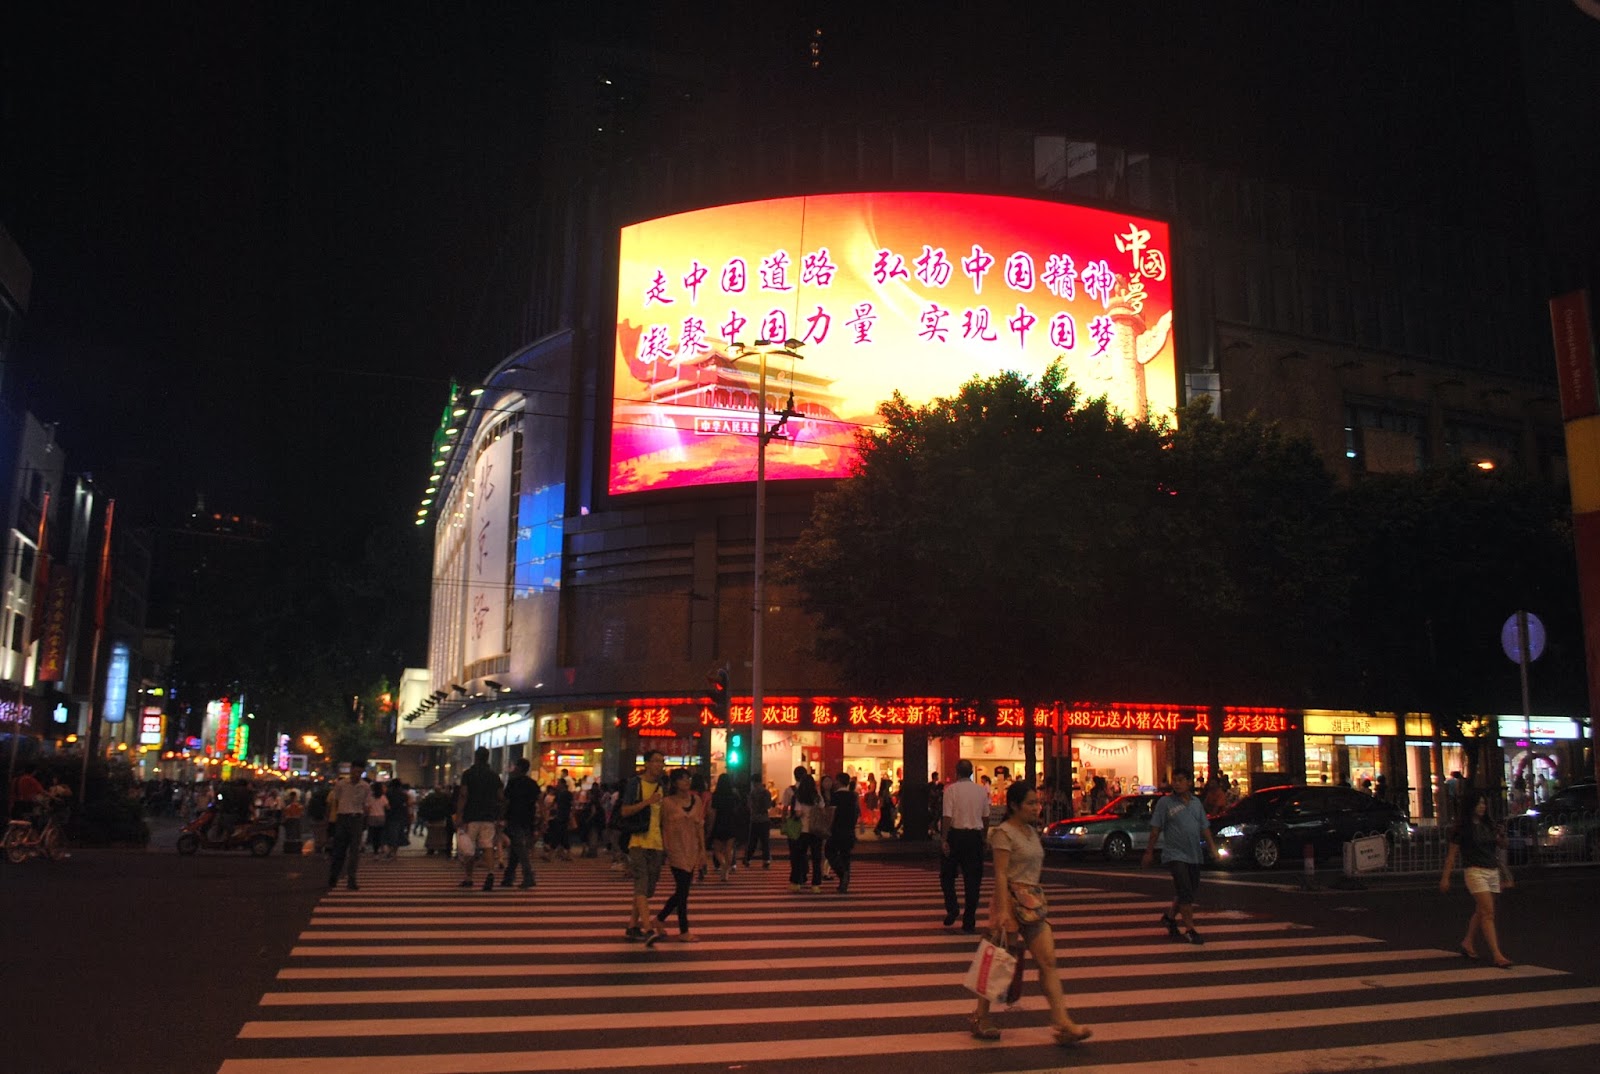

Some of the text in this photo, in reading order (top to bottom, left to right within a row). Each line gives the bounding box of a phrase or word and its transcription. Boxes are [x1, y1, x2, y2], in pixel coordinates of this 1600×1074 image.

[646, 246, 1116, 309] 走中国道路 弘扬中国精神
[1113, 222, 1167, 316] 中國夢
[639, 301, 1116, 361] 凝聚中国力量 实现中国梦
[471, 455, 495, 640] 北京路
